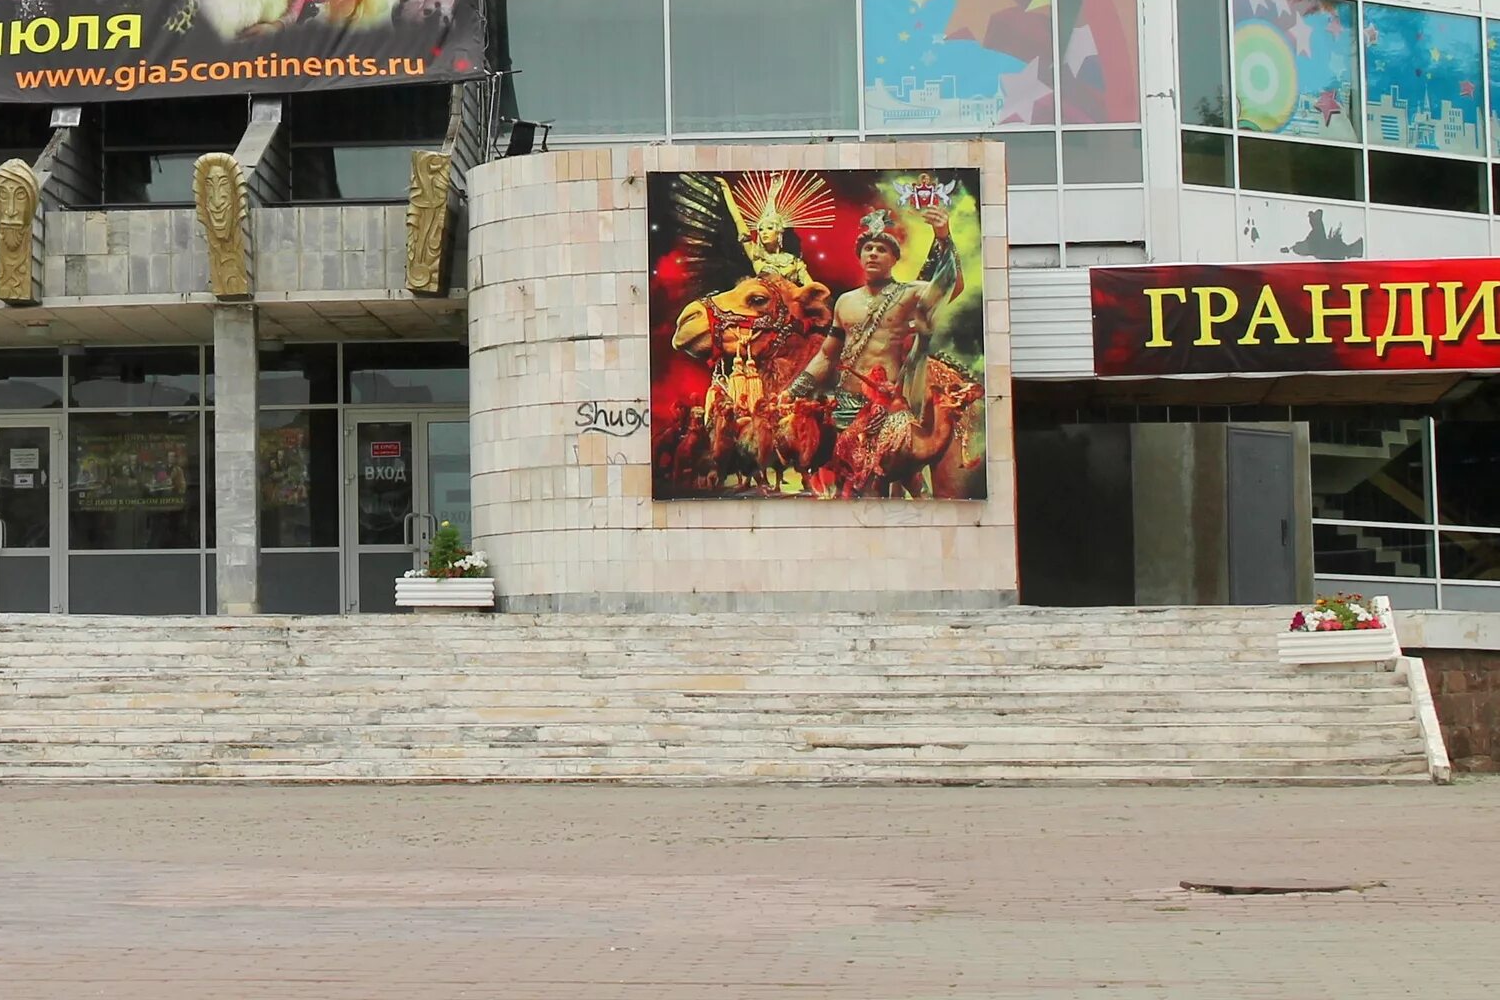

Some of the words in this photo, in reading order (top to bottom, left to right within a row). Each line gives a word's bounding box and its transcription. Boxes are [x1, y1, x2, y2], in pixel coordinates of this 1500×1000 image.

[16, 52, 425, 92] www.gia5continents.ru
[1143, 281, 1500, 357] ГРАНДИ
[365, 466, 406, 482] ВХОД
